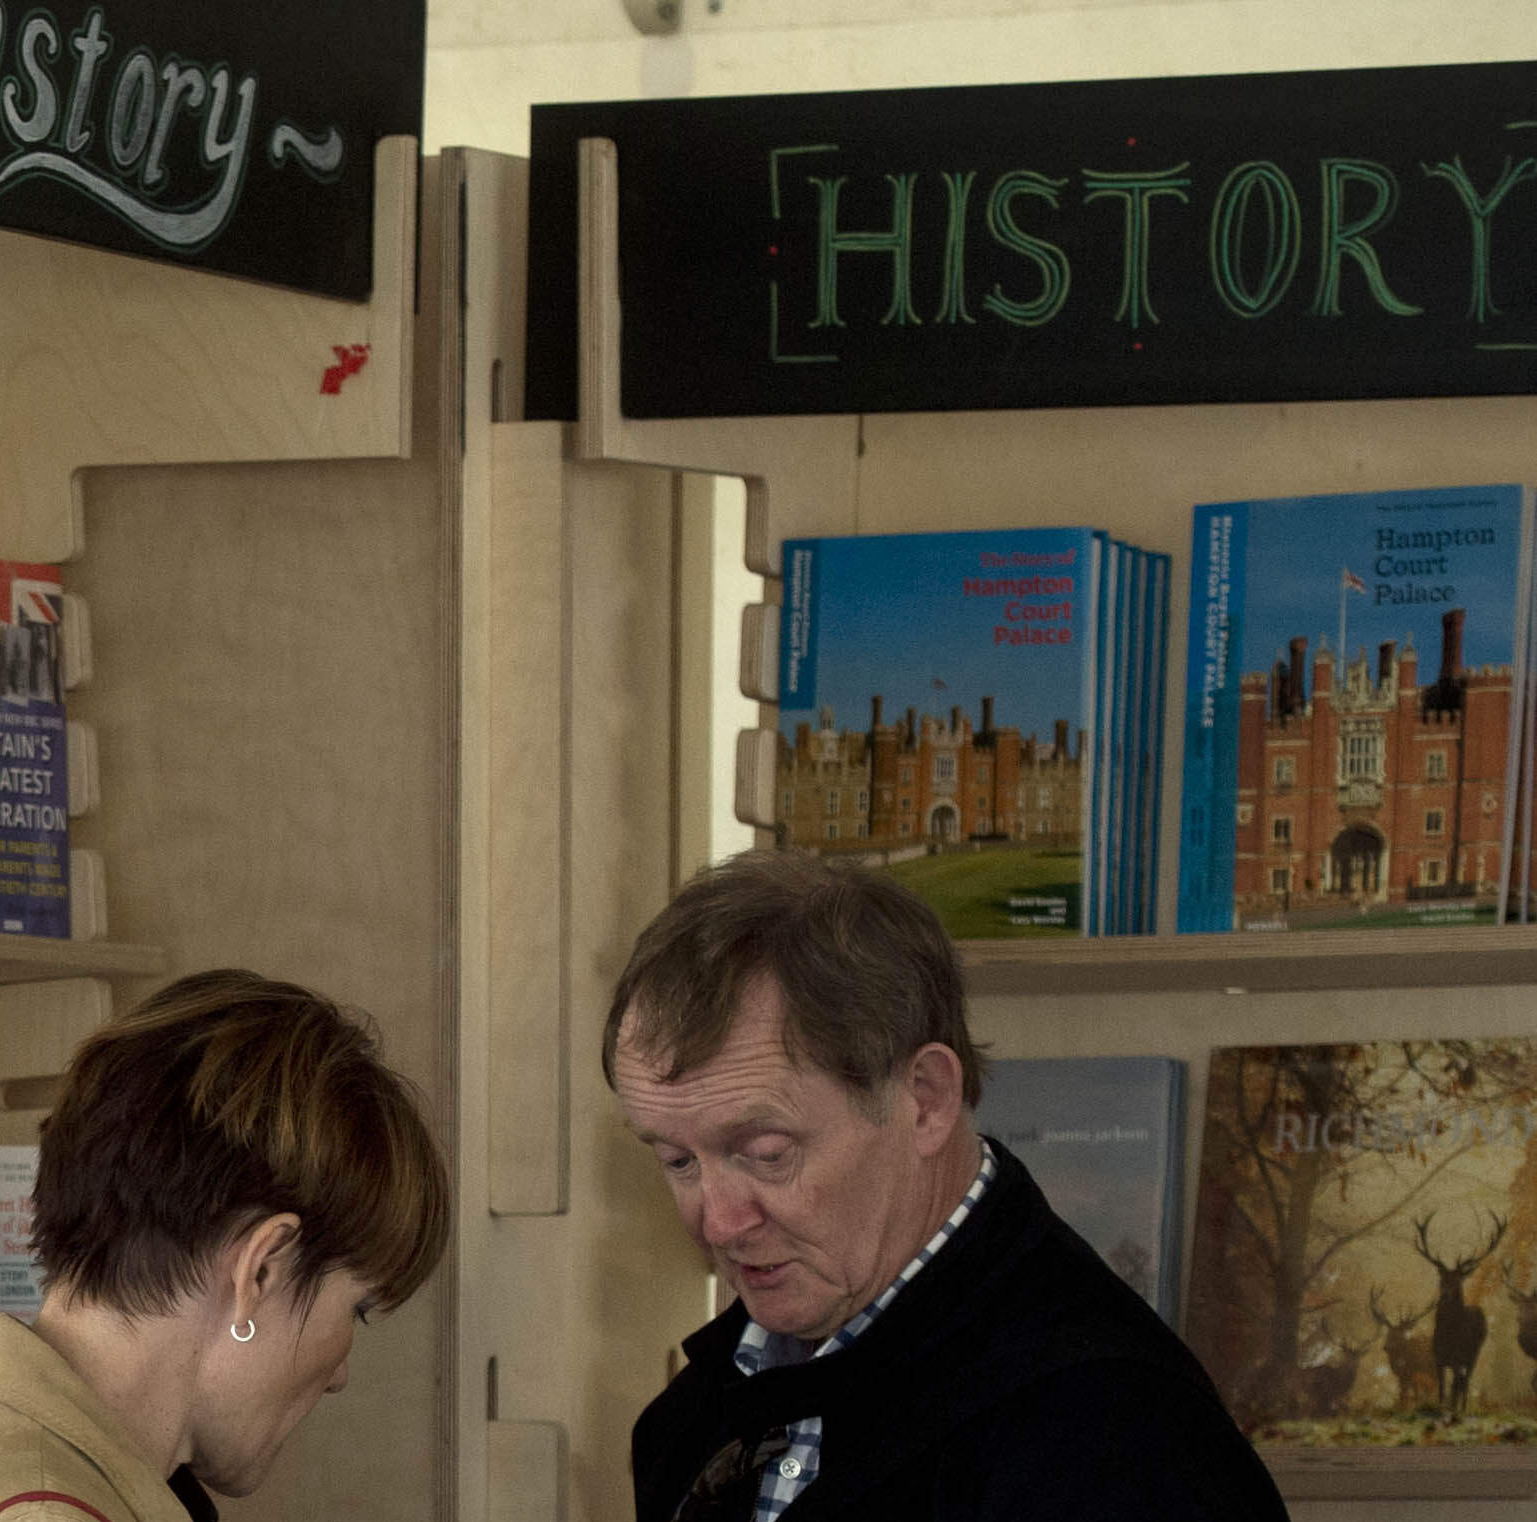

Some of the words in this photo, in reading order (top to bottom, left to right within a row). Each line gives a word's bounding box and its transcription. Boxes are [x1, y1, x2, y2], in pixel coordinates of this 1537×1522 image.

[807, 153, 1537, 328] HISTORY
[1375, 525, 1496, 552] Hampton
[1375, 554, 1449, 578] Court
[963, 575, 1075, 599] Hampton
[1374, 580, 1457, 607] Palace
[1004, 601, 1073, 623] Court
[993, 626, 1073, 646] Palace
[1273, 1105, 1535, 1157] RICHMOND
